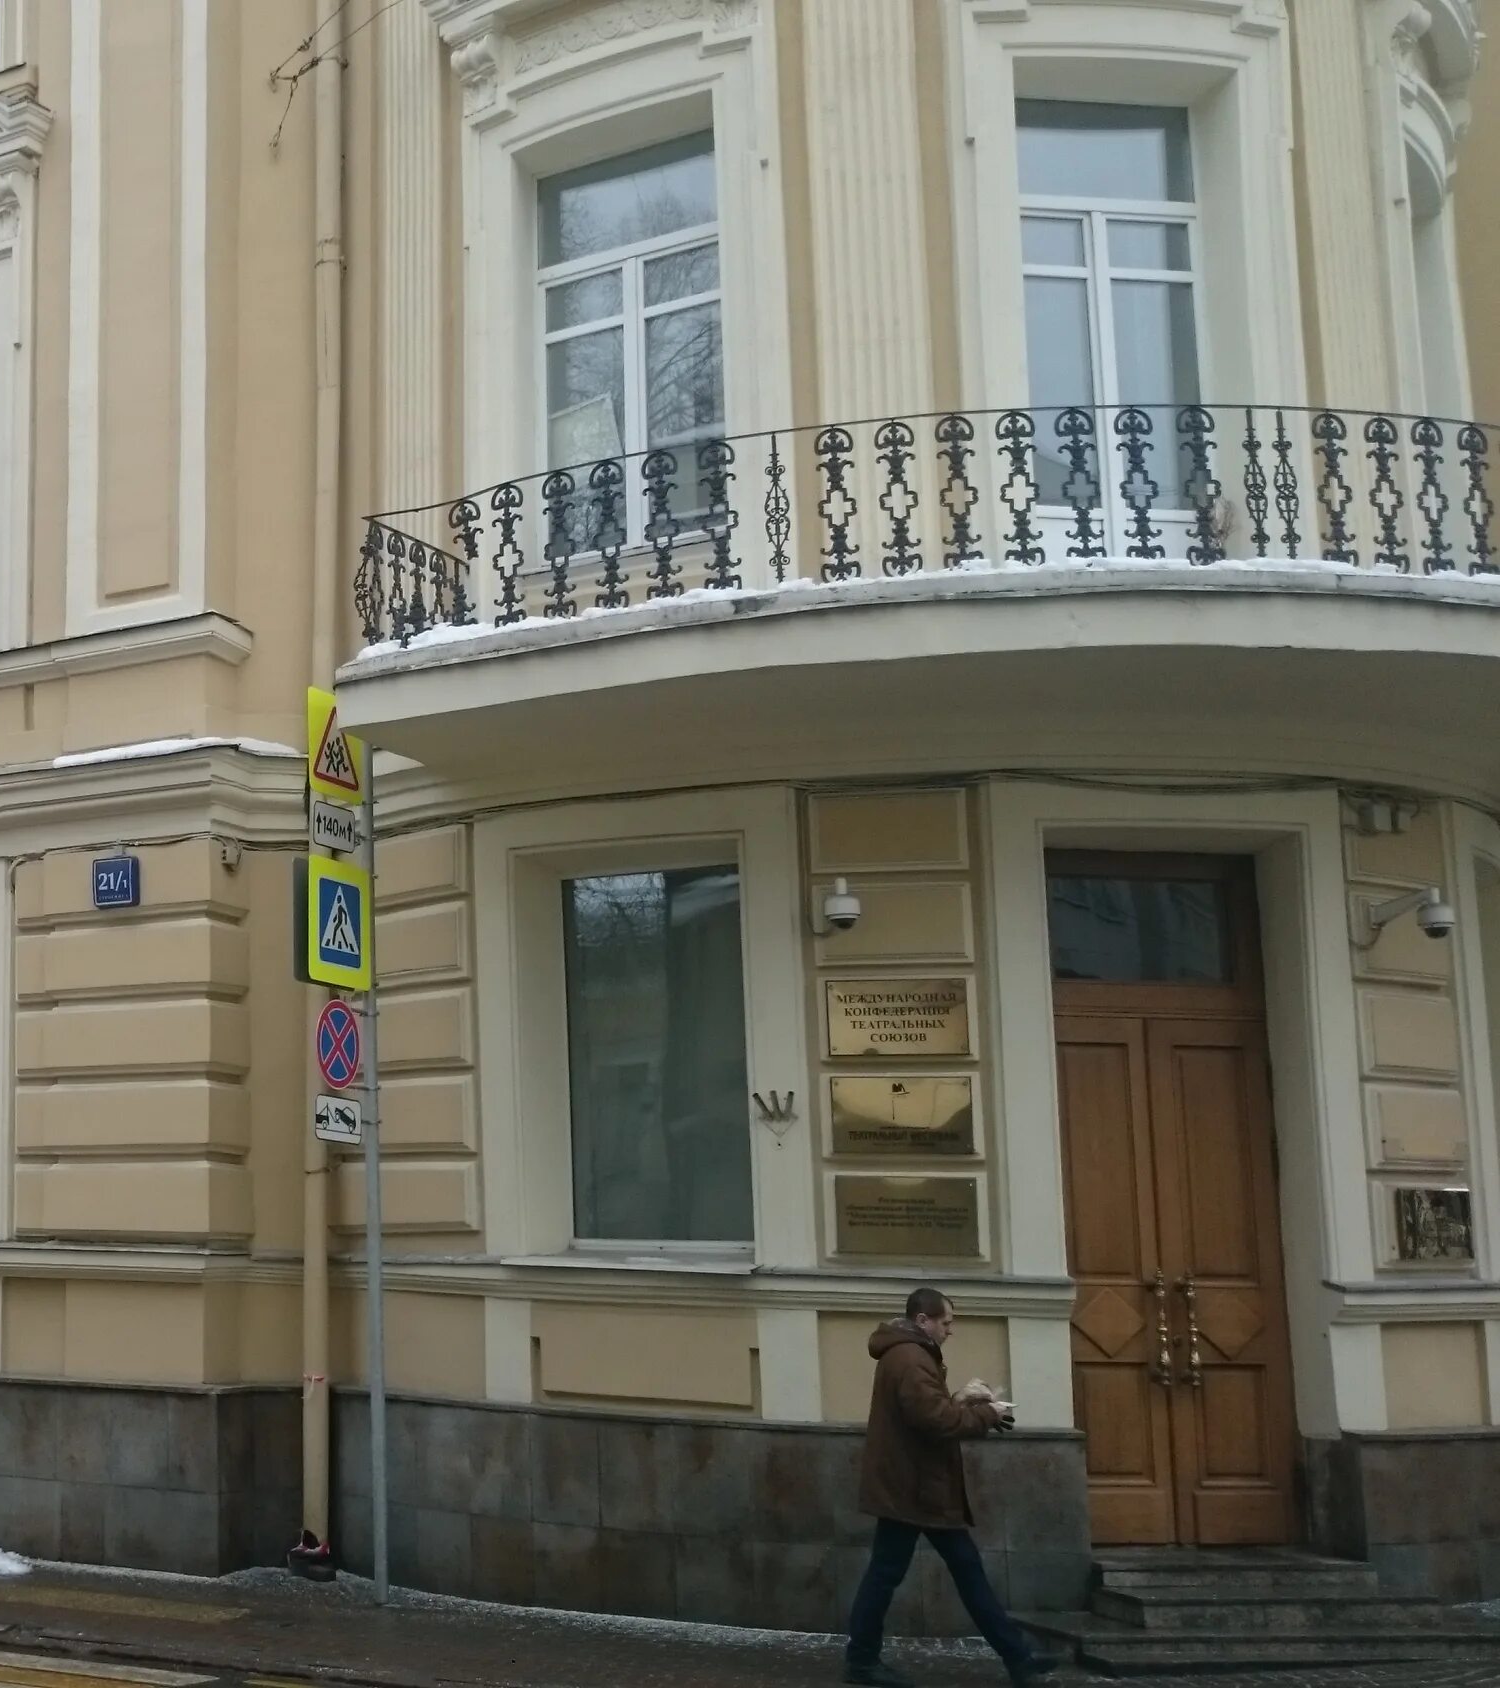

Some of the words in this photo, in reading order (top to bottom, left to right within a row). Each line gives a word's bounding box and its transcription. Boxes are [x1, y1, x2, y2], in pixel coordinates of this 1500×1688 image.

[322, 815, 346, 839] 140м
[98, 870, 127, 891] 21/1
[836, 992, 957, 1003] МЕЖДУНАРОДНАЯ
[844, 1006, 950, 1017] КОНФЕДЕРАЦИЯ
[850, 1019, 947, 1030] ТЕАТРАЛЬНЫХ
[870, 1032, 927, 1043] СОЮЗОВ
